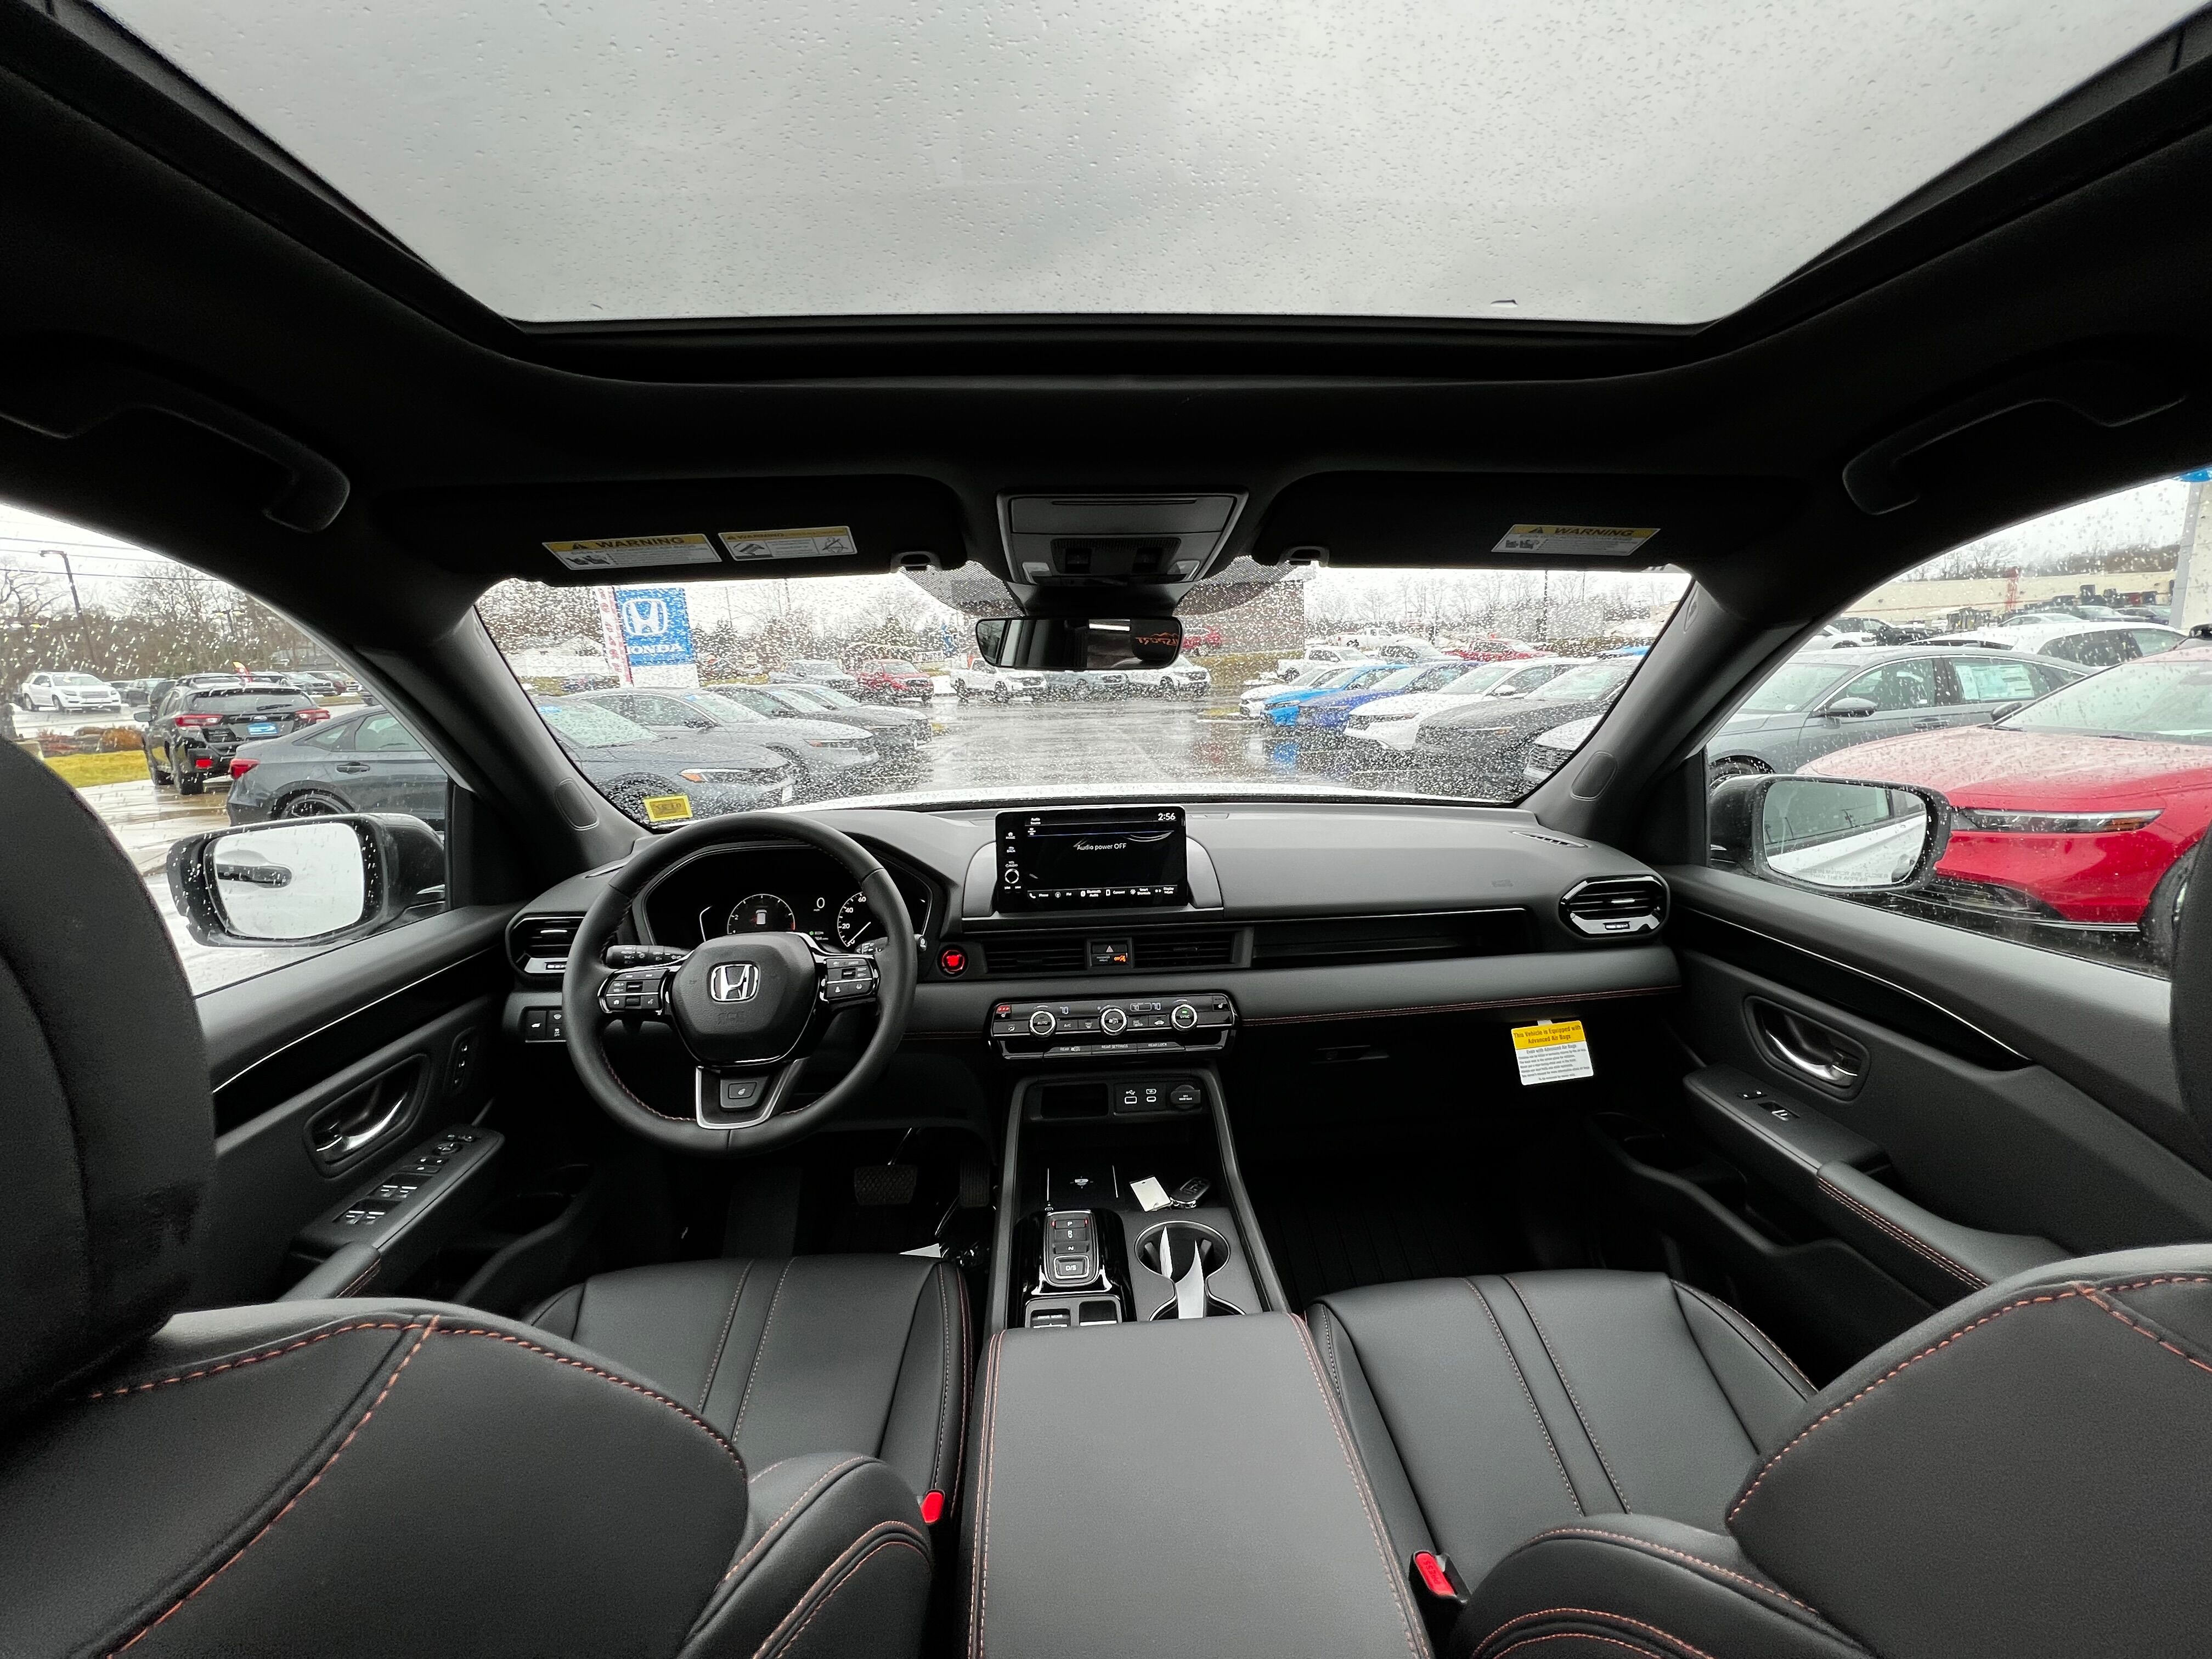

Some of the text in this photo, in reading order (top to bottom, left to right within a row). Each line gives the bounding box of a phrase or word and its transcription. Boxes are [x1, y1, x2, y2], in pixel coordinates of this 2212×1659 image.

[1554, 528, 1634, 537] WARNING
[596, 537, 685, 548] WARNING
[1158, 812, 1176, 821] 2:56
[816, 897, 825, 909] 0
[1549, 1026, 1571, 1035] Equipped
[1528, 1035, 1550, 1044] Advanced
